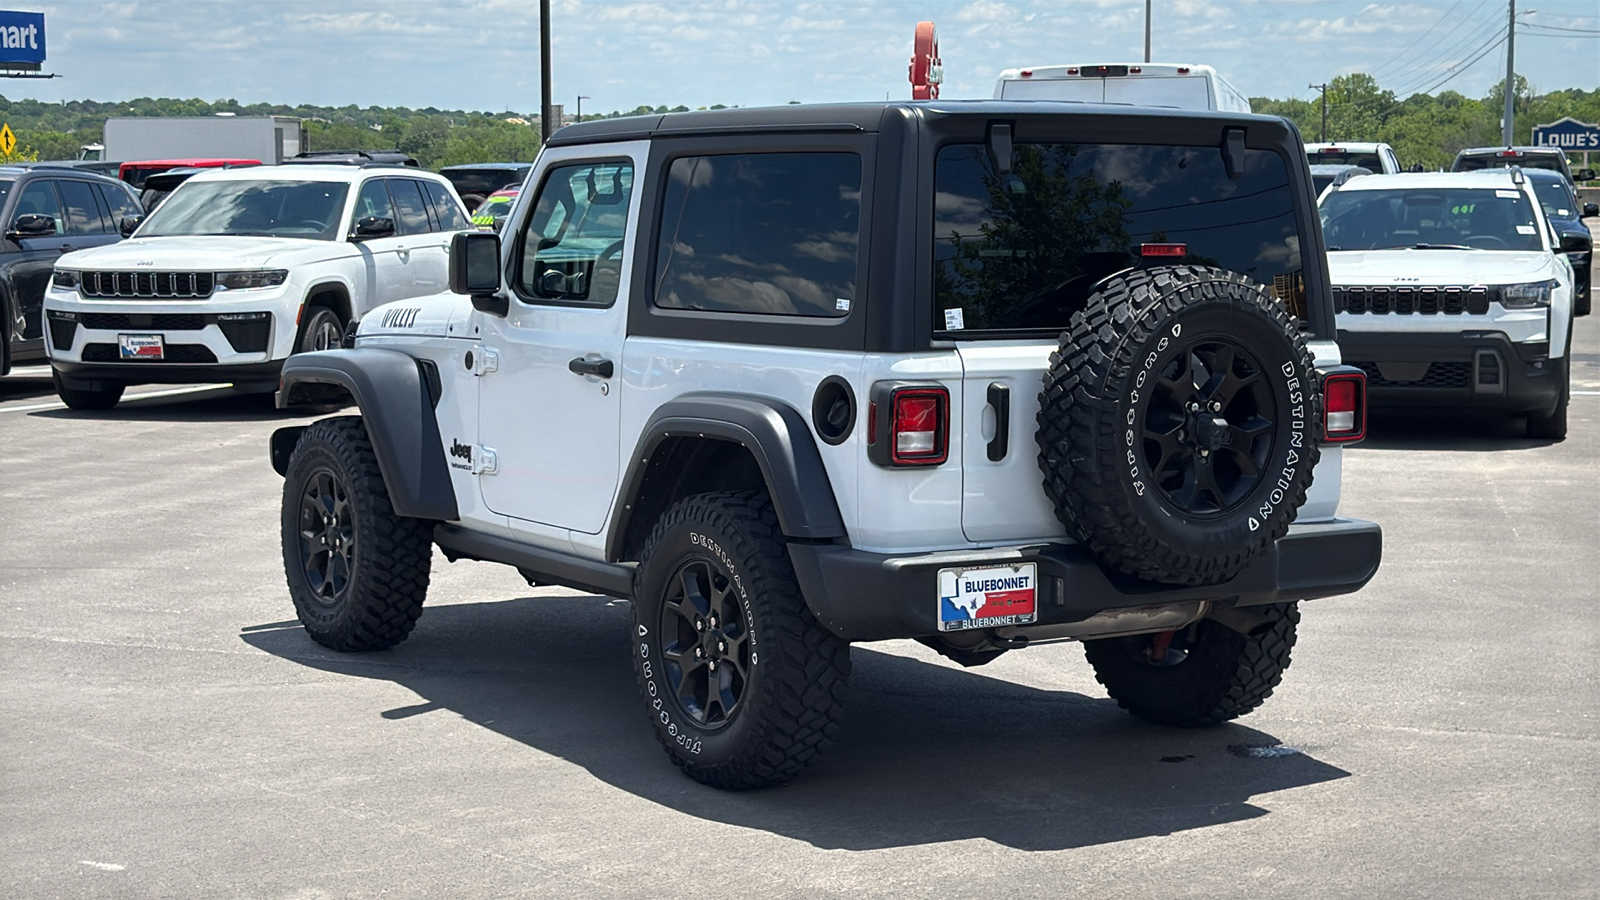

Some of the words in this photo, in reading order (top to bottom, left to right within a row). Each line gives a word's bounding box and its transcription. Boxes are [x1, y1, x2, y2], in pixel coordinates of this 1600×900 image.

[1538, 131, 1599, 147] LOWE'S
[381, 307, 422, 328] WILLYS
[1259, 361, 1304, 519] DESTINATION
[690, 532, 757, 646] DESTINATION
[965, 576, 1029, 593] BLUEBONNET
[962, 615, 1016, 629] BLUEBONNET
